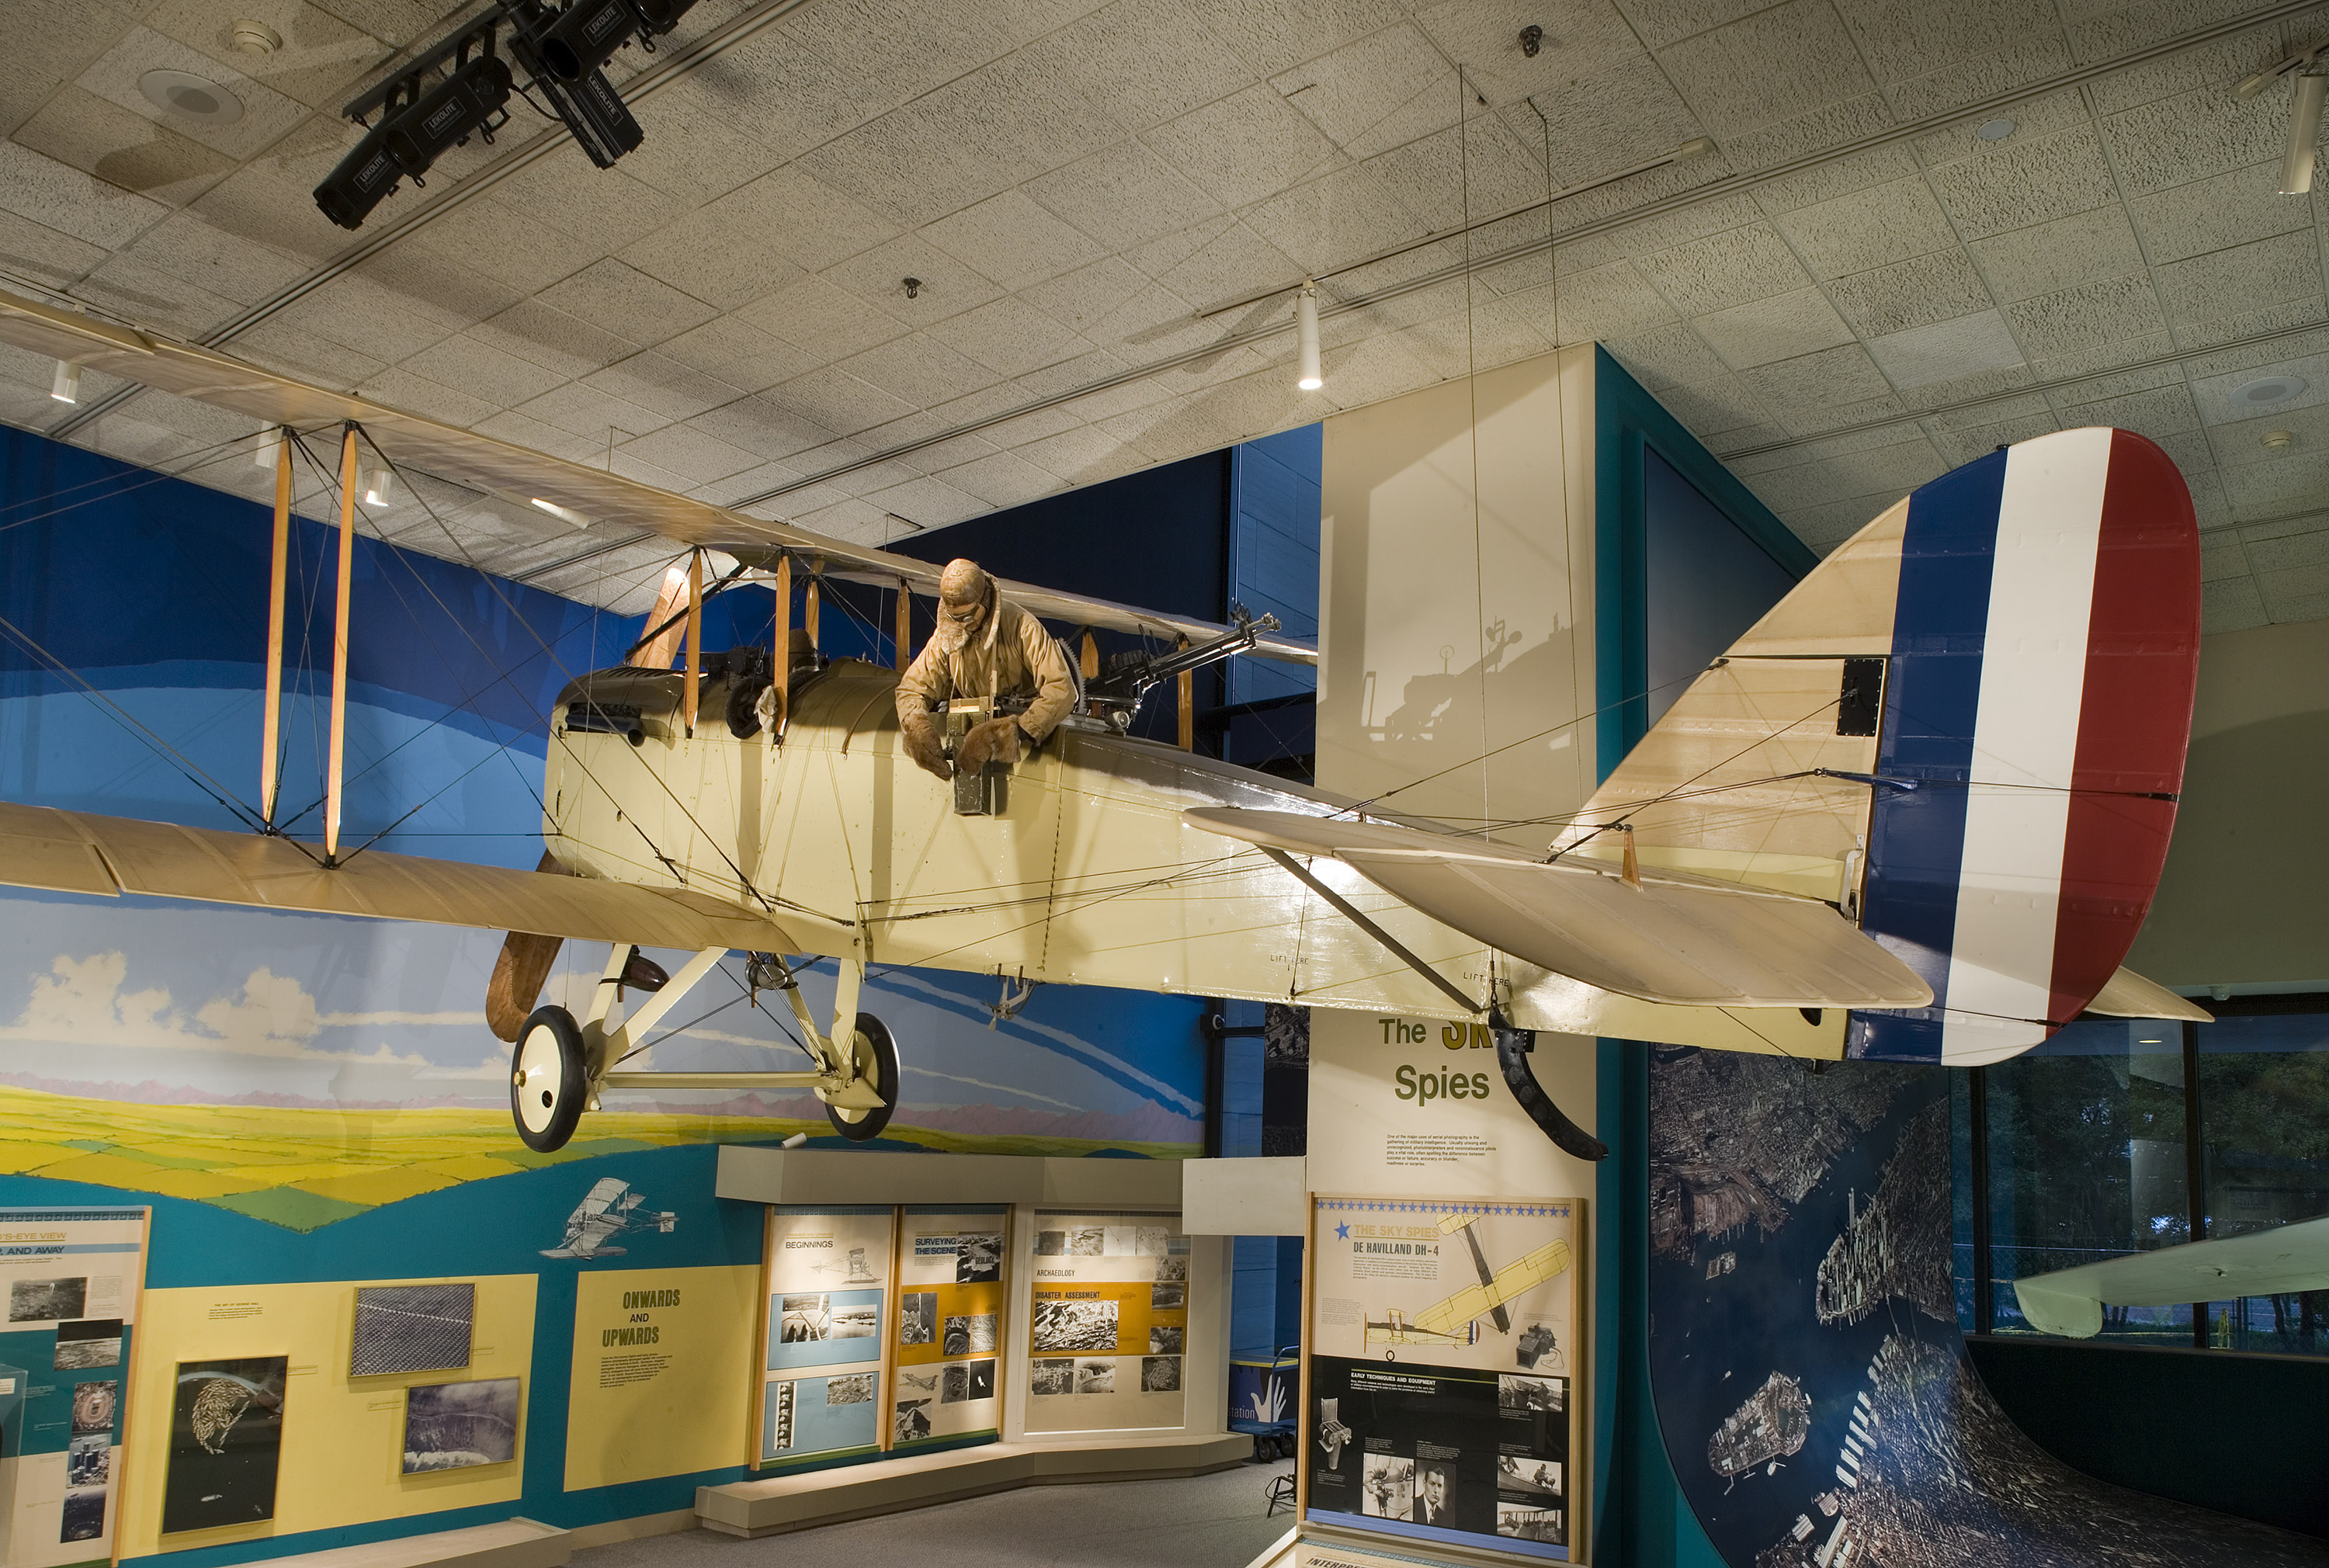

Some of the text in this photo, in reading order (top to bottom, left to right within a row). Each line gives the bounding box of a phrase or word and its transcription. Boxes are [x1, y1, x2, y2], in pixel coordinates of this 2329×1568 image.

[588, 6, 616, 34] LEKOLITE
[588, 75, 617, 115] LEKOLITE
[429, 102, 456, 129] LEKOLITE
[359, 155, 386, 182] LEKOLITE
[1463, 971, 1484, 982] LIFT
[1379, 1018, 1494, 1050] The SK
[1394, 1064, 1490, 1107] Spies
[1354, 1224, 1439, 1238] THE SKY SPIES
[915, 1237, 956, 1246] SURVEYING
[1354, 1242, 1364, 1253] DE
[1366, 1242, 1411, 1255] HAVILLAND
[7, 1247, 32, 1255] AND
[35, 1246, 65, 1254] AWAY
[975, 1256, 994, 1264] GEOLOGY
[623, 1289, 681, 1310] ONWARDS
[1035, 1291, 1101, 1299] DISASTER ASSESSMENT
[630, 1313, 649, 1323] AND
[602, 1326, 659, 1347] UPWARDS
[1366, 1373, 1396, 1382] TECHNIQUES
